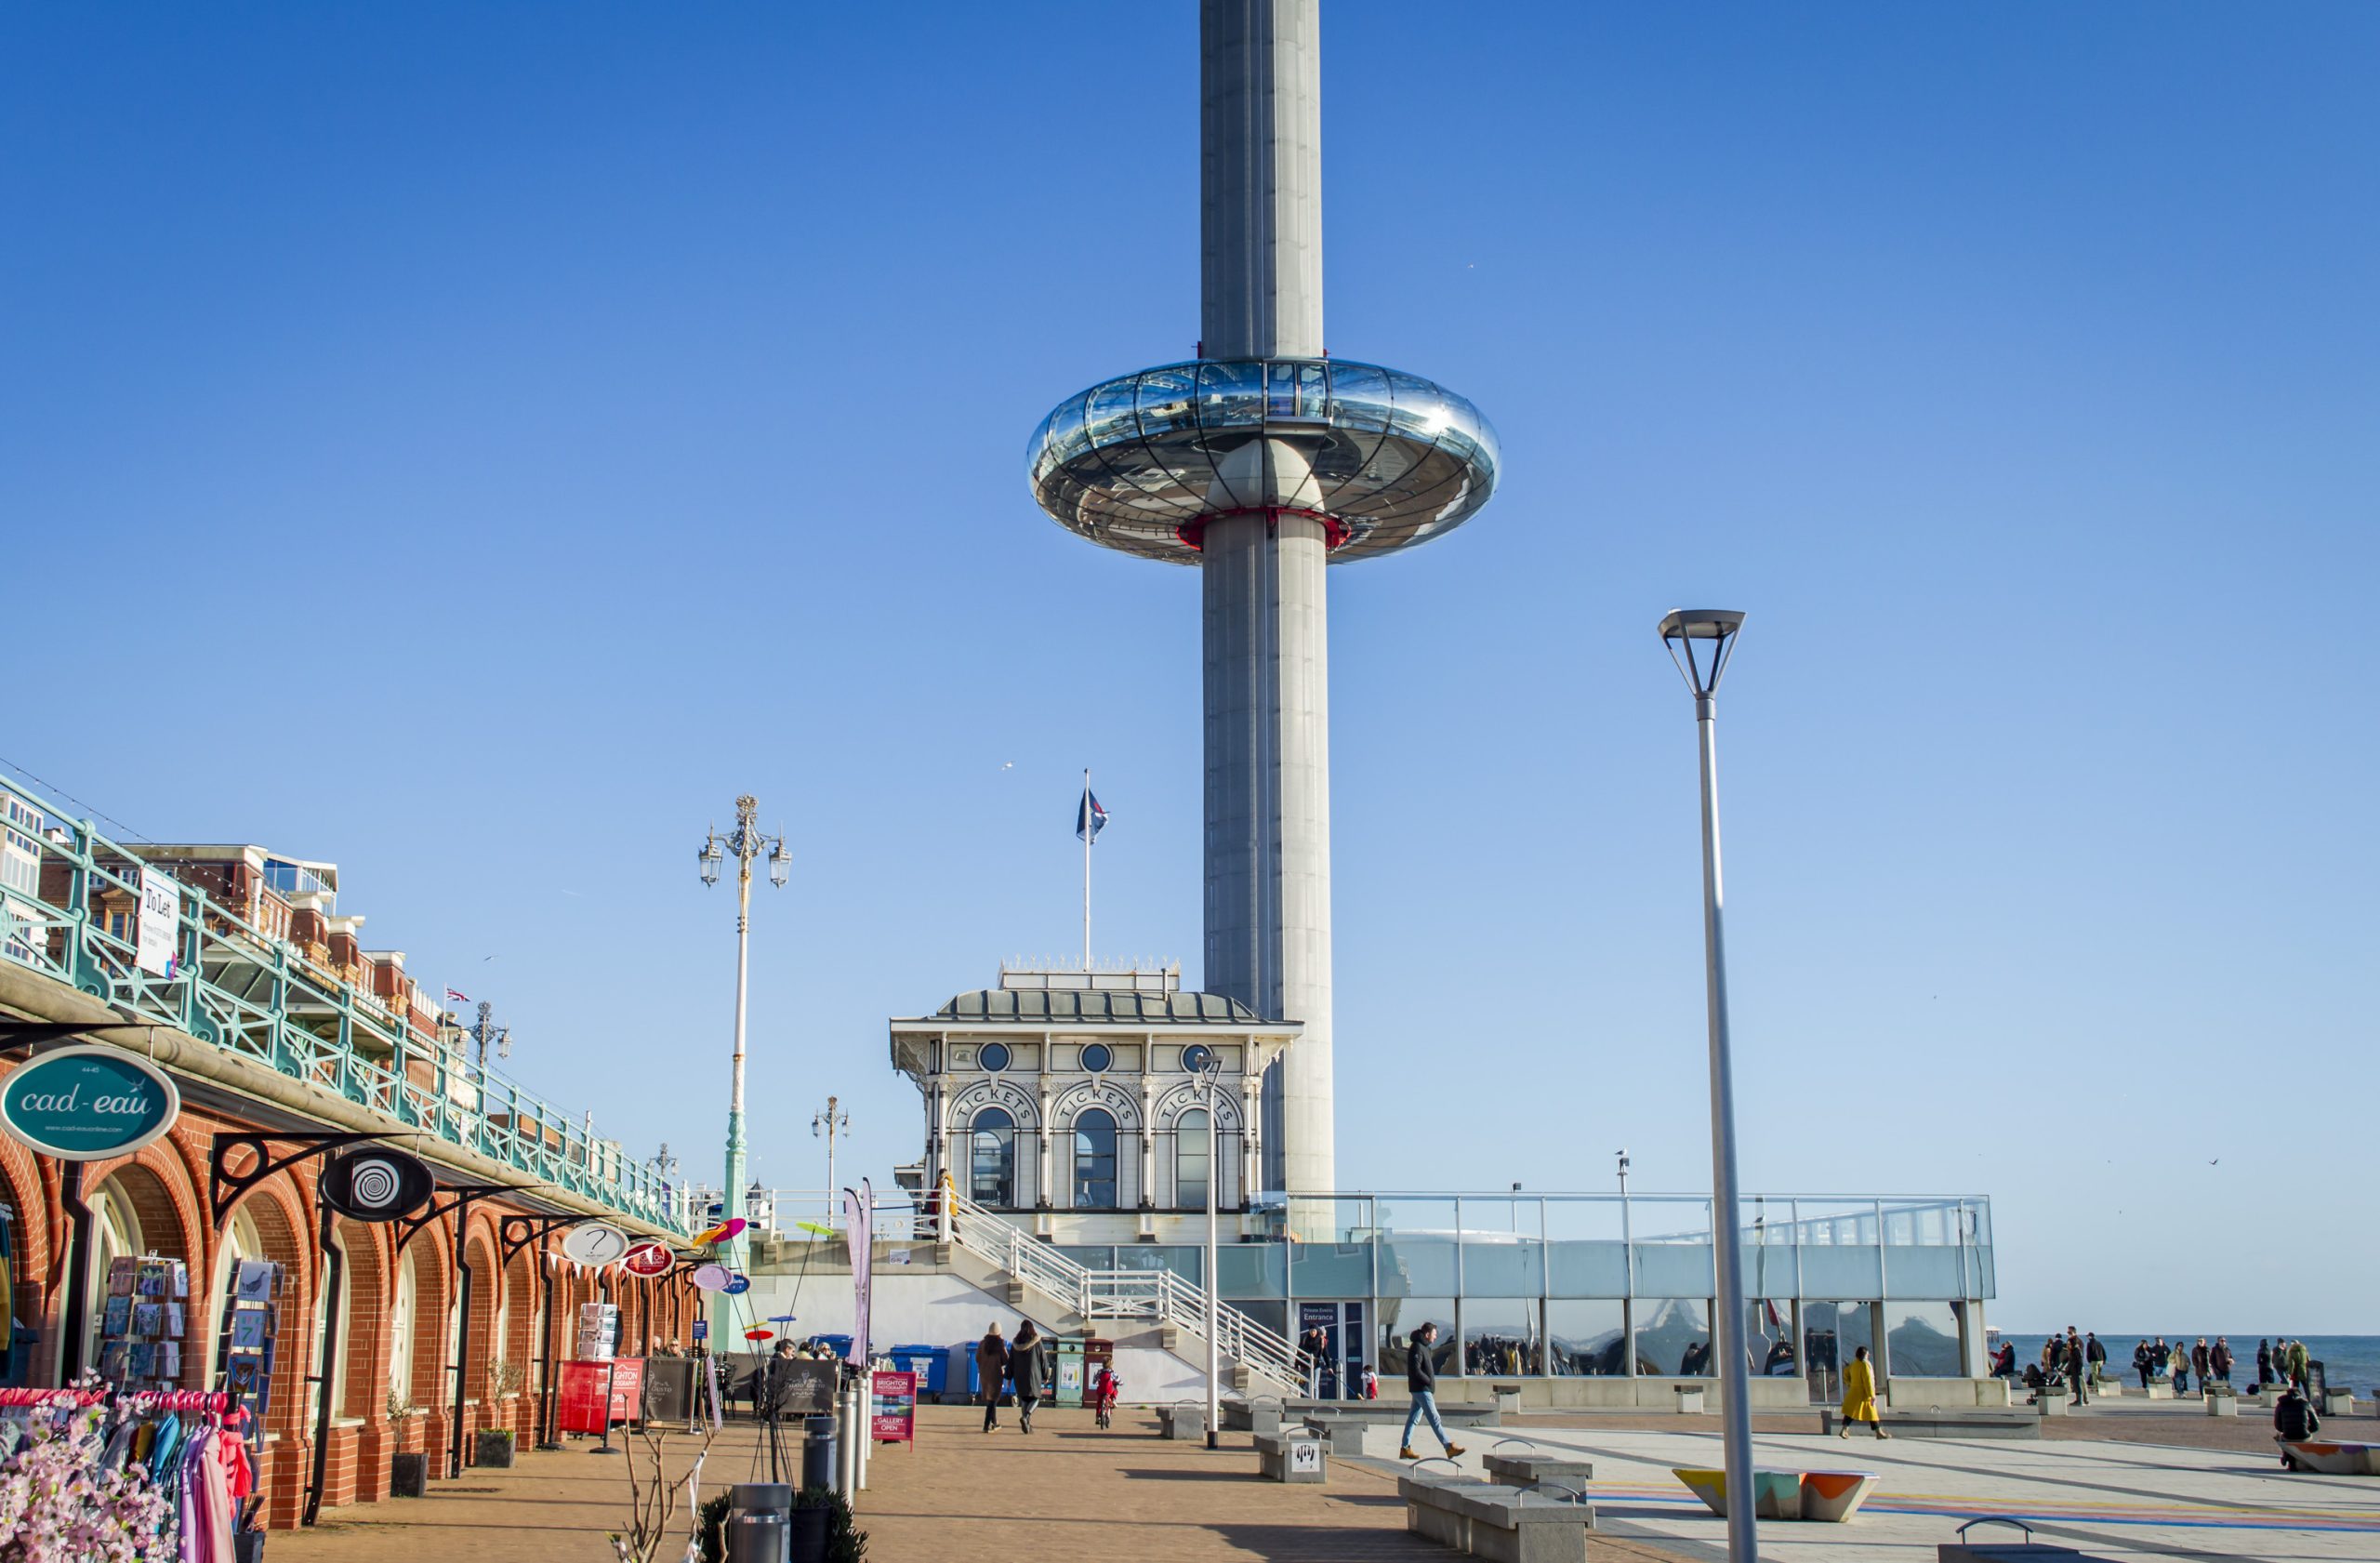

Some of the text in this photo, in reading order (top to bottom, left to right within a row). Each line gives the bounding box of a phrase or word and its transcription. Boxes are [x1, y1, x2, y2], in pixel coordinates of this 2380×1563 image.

[146, 888, 170, 919] To Let
[957, 1088, 1030, 1119] TICKETS
[1060, 1089, 1132, 1120] TICKETS
[1161, 1090, 1233, 1120] TICKTS
[614, 1371, 638, 1380] IGHTON
